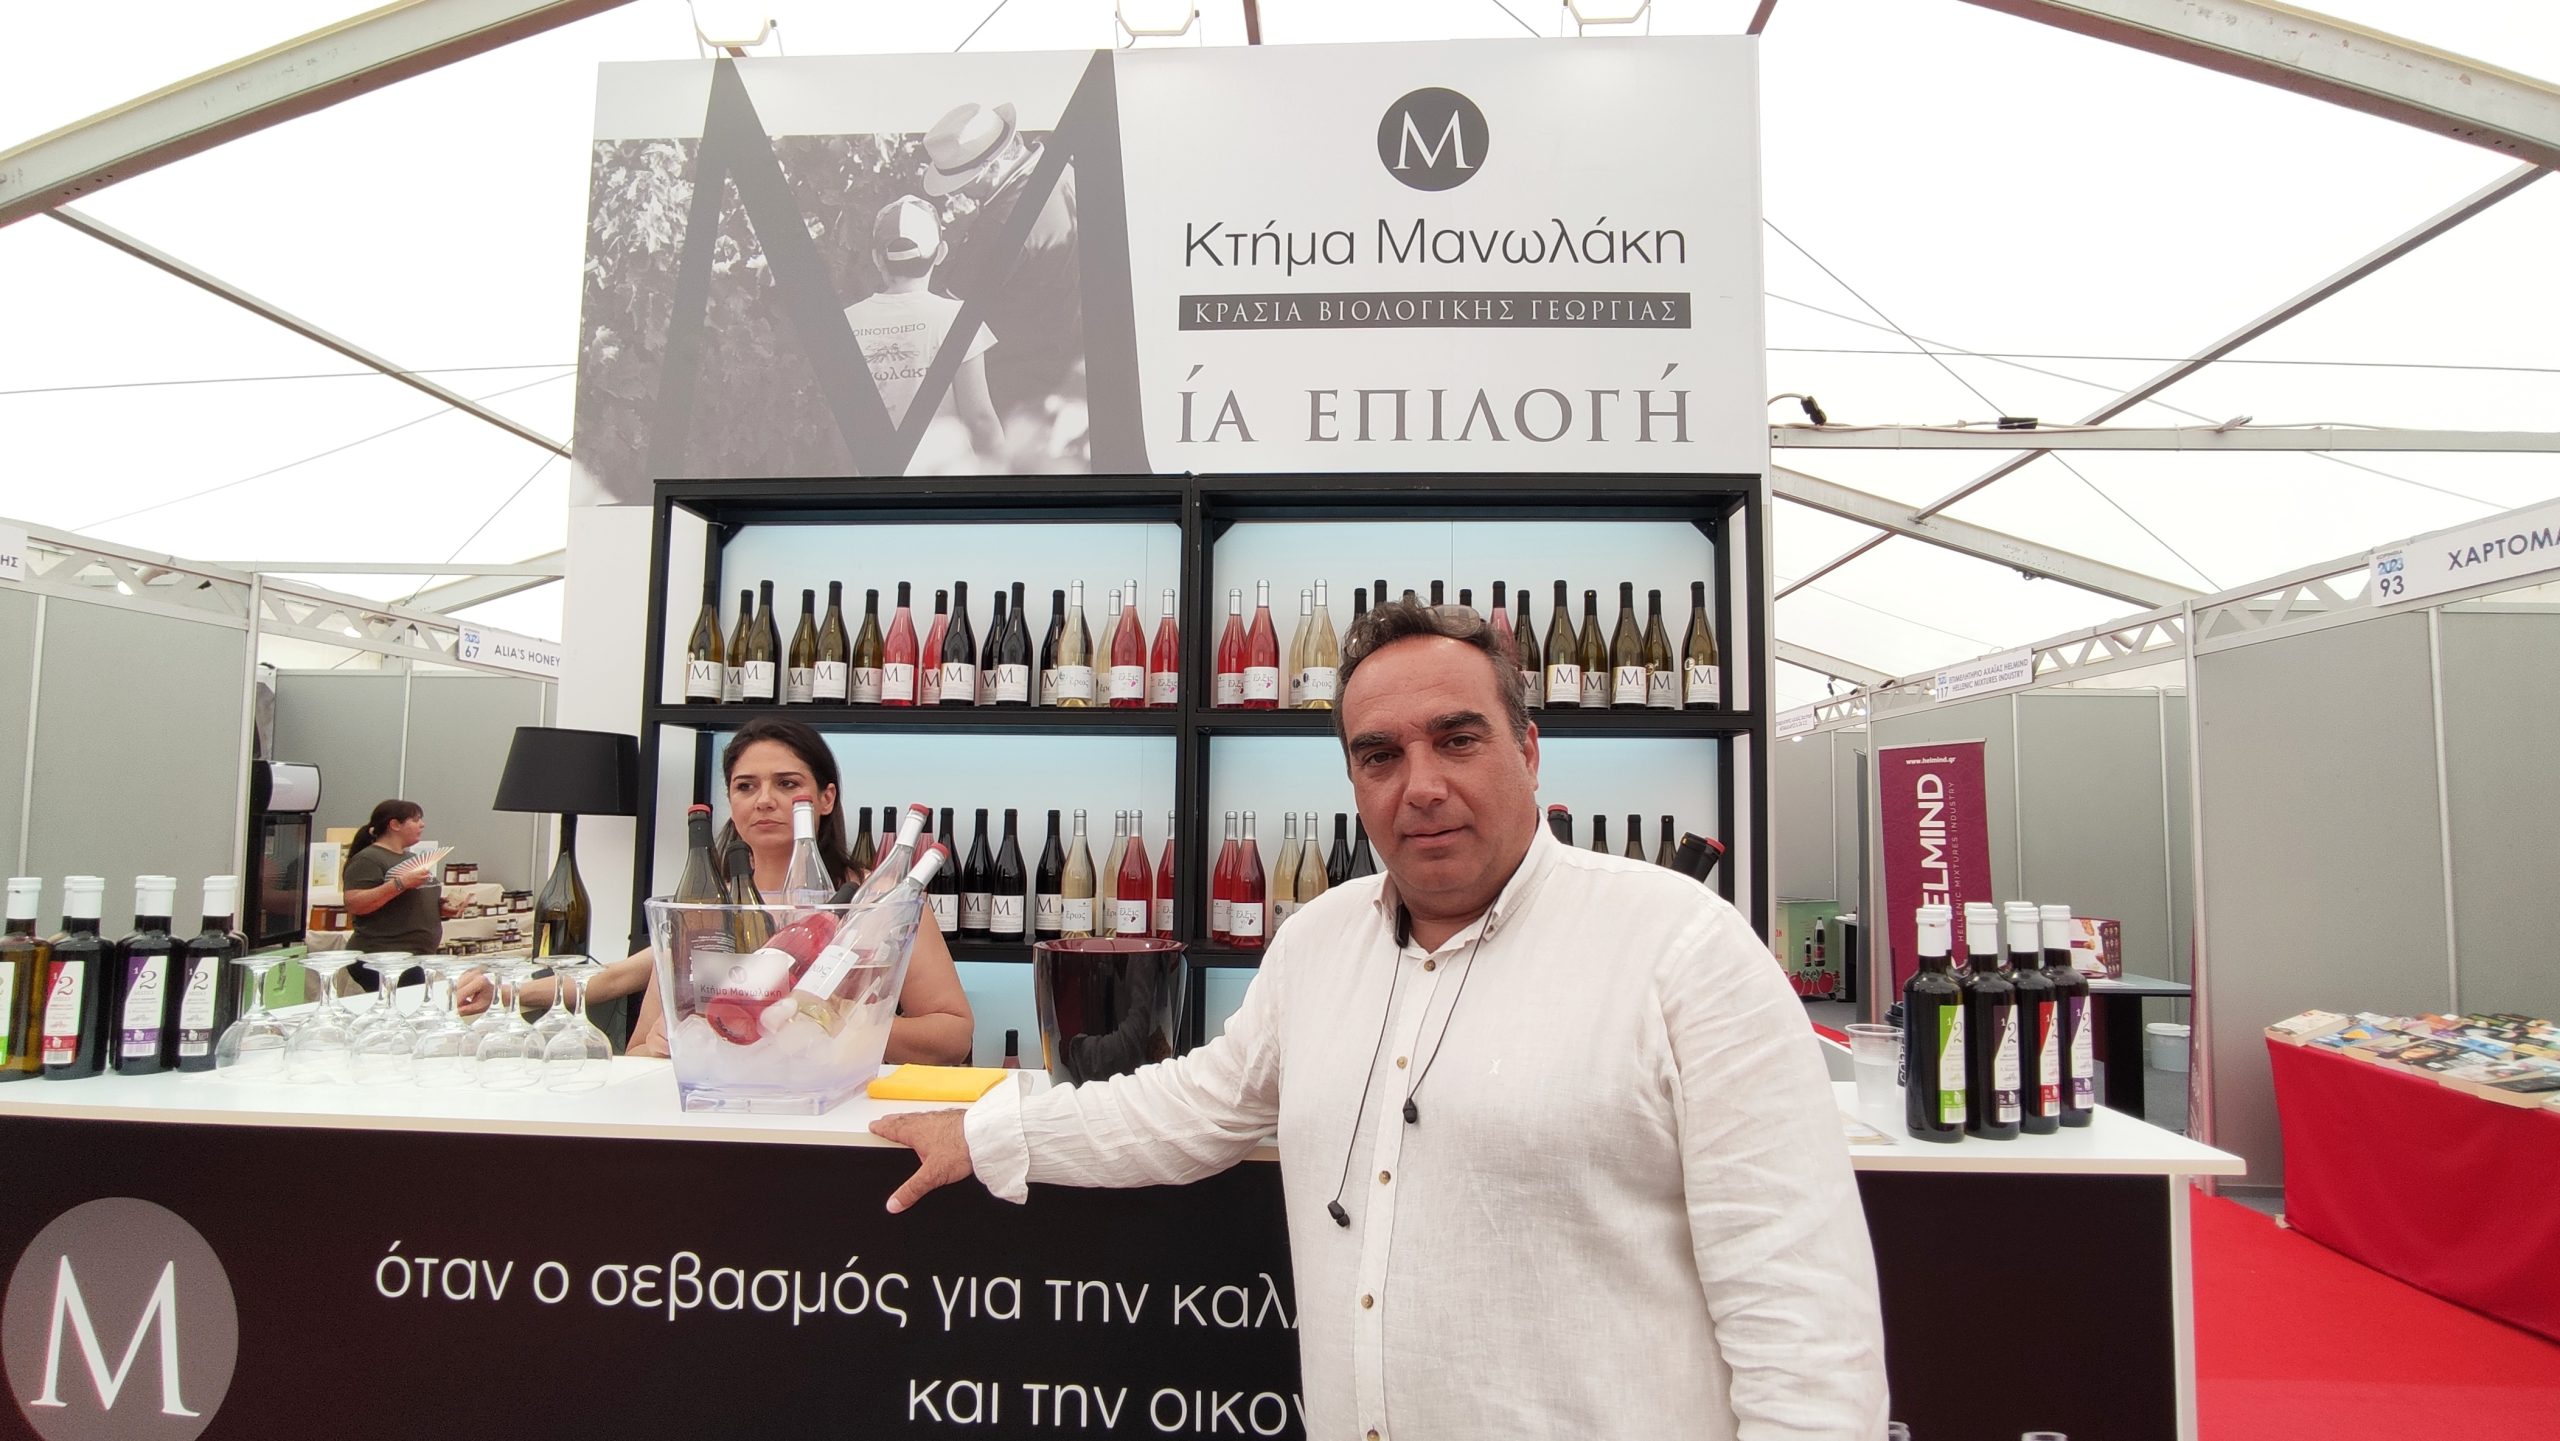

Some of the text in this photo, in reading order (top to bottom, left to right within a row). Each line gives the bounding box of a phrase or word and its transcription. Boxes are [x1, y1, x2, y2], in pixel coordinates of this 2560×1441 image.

[1393, 109, 1473, 170] M
[1185, 216, 1686, 277] Κτήμα Μανωλάκη
[1195, 299, 1677, 324] ΚΡΑΣΙΑ ΒΙΟΛΟΓΙΚΗΣ ΓΕΩΡΓΙΑΣ
[1304, 363, 1695, 443] ΕΠΙΛΟΓΉ
[2380, 575, 2405, 598] 93
[465, 645, 480, 659] 67
[494, 644, 561, 667] ALIA'S HONEY
[691, 664, 711, 681] M
[726, 669, 741, 685] M
[744, 663, 759, 680] M
[788, 670, 804, 686] M
[815, 664, 833, 681] M
[853, 670, 871, 686] M
[884, 666, 899, 683] M
[923, 671, 940, 688] M
[944, 666, 963, 683] M
[982, 671, 996, 688] M
[997, 667, 1013, 683] M
[1555, 666, 1575, 684] M
[1620, 668, 1640, 686] M
[1693, 668, 1713, 685] M
[1974, 676, 1998, 687] MIXTURES
[1998, 670, 2024, 682] INDUSTRY
[1521, 672, 1538, 690] M
[1584, 674, 1604, 691] M
[1652, 674, 1671, 690] M
[1936, 686, 1949, 699] 117
[1906, 756, 1957, 765] www.helmind.gr
[1917, 773, 1949, 905] ELMIND
[1948, 782, 1964, 942] HELLENIC MIXTURES INDUSTRY
[964, 895, 980, 912] M
[993, 897, 1010, 915] M
[1037, 896, 1053, 914] M
[58, 975, 74, 996] 2
[140, 970, 157, 990] 2
[193, 971, 209, 990] 2
[1953, 1021, 1963, 1043] 2
[2007, 1021, 2017, 1044] 2
[374, 1240, 1299, 1332] όταν ο σεβασμός για την καλ
[30, 1254, 201, 1417] M
[908, 1379, 999, 1425] και
[1022, 1382, 1127, 1429] την
